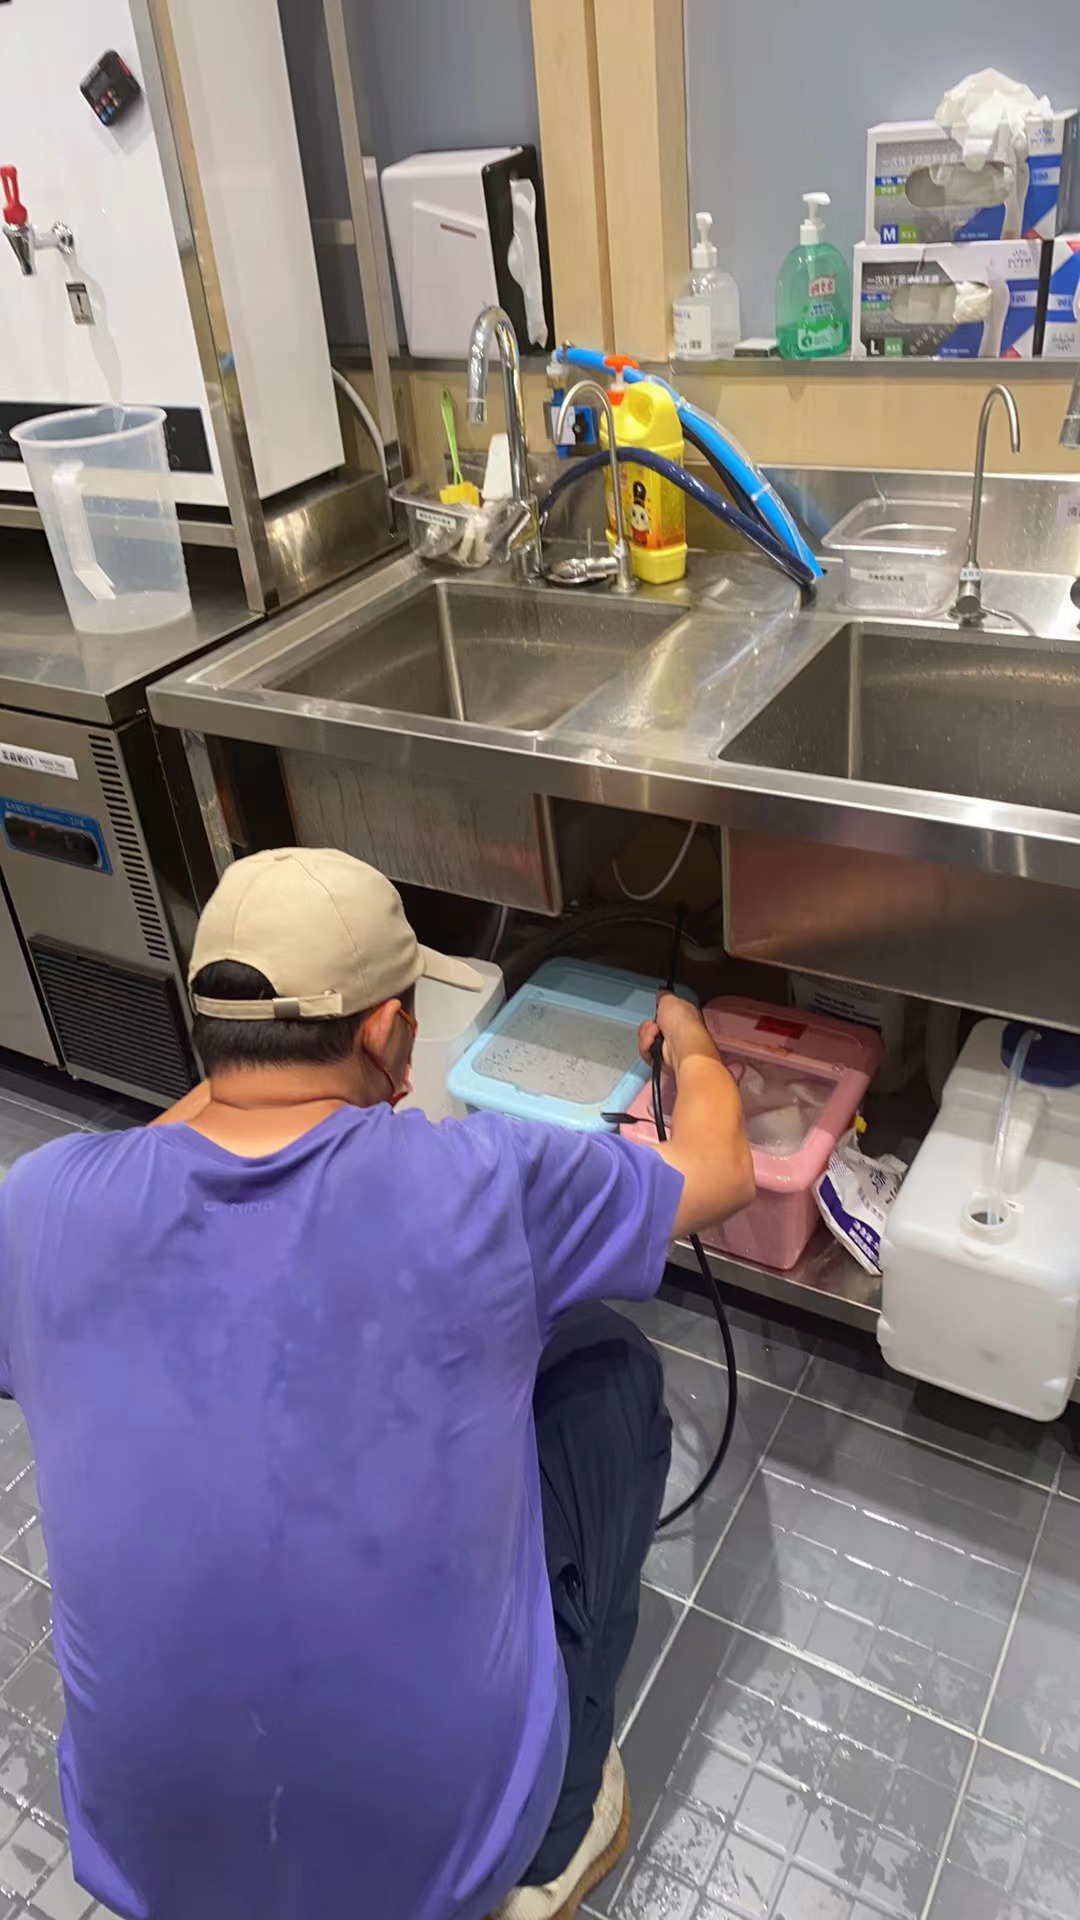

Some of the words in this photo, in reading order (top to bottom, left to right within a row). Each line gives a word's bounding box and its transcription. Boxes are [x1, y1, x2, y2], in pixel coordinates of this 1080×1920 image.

[883, 227, 896, 241] M
[1012, 295, 1026, 304] 100
[870, 340, 880, 355] L
